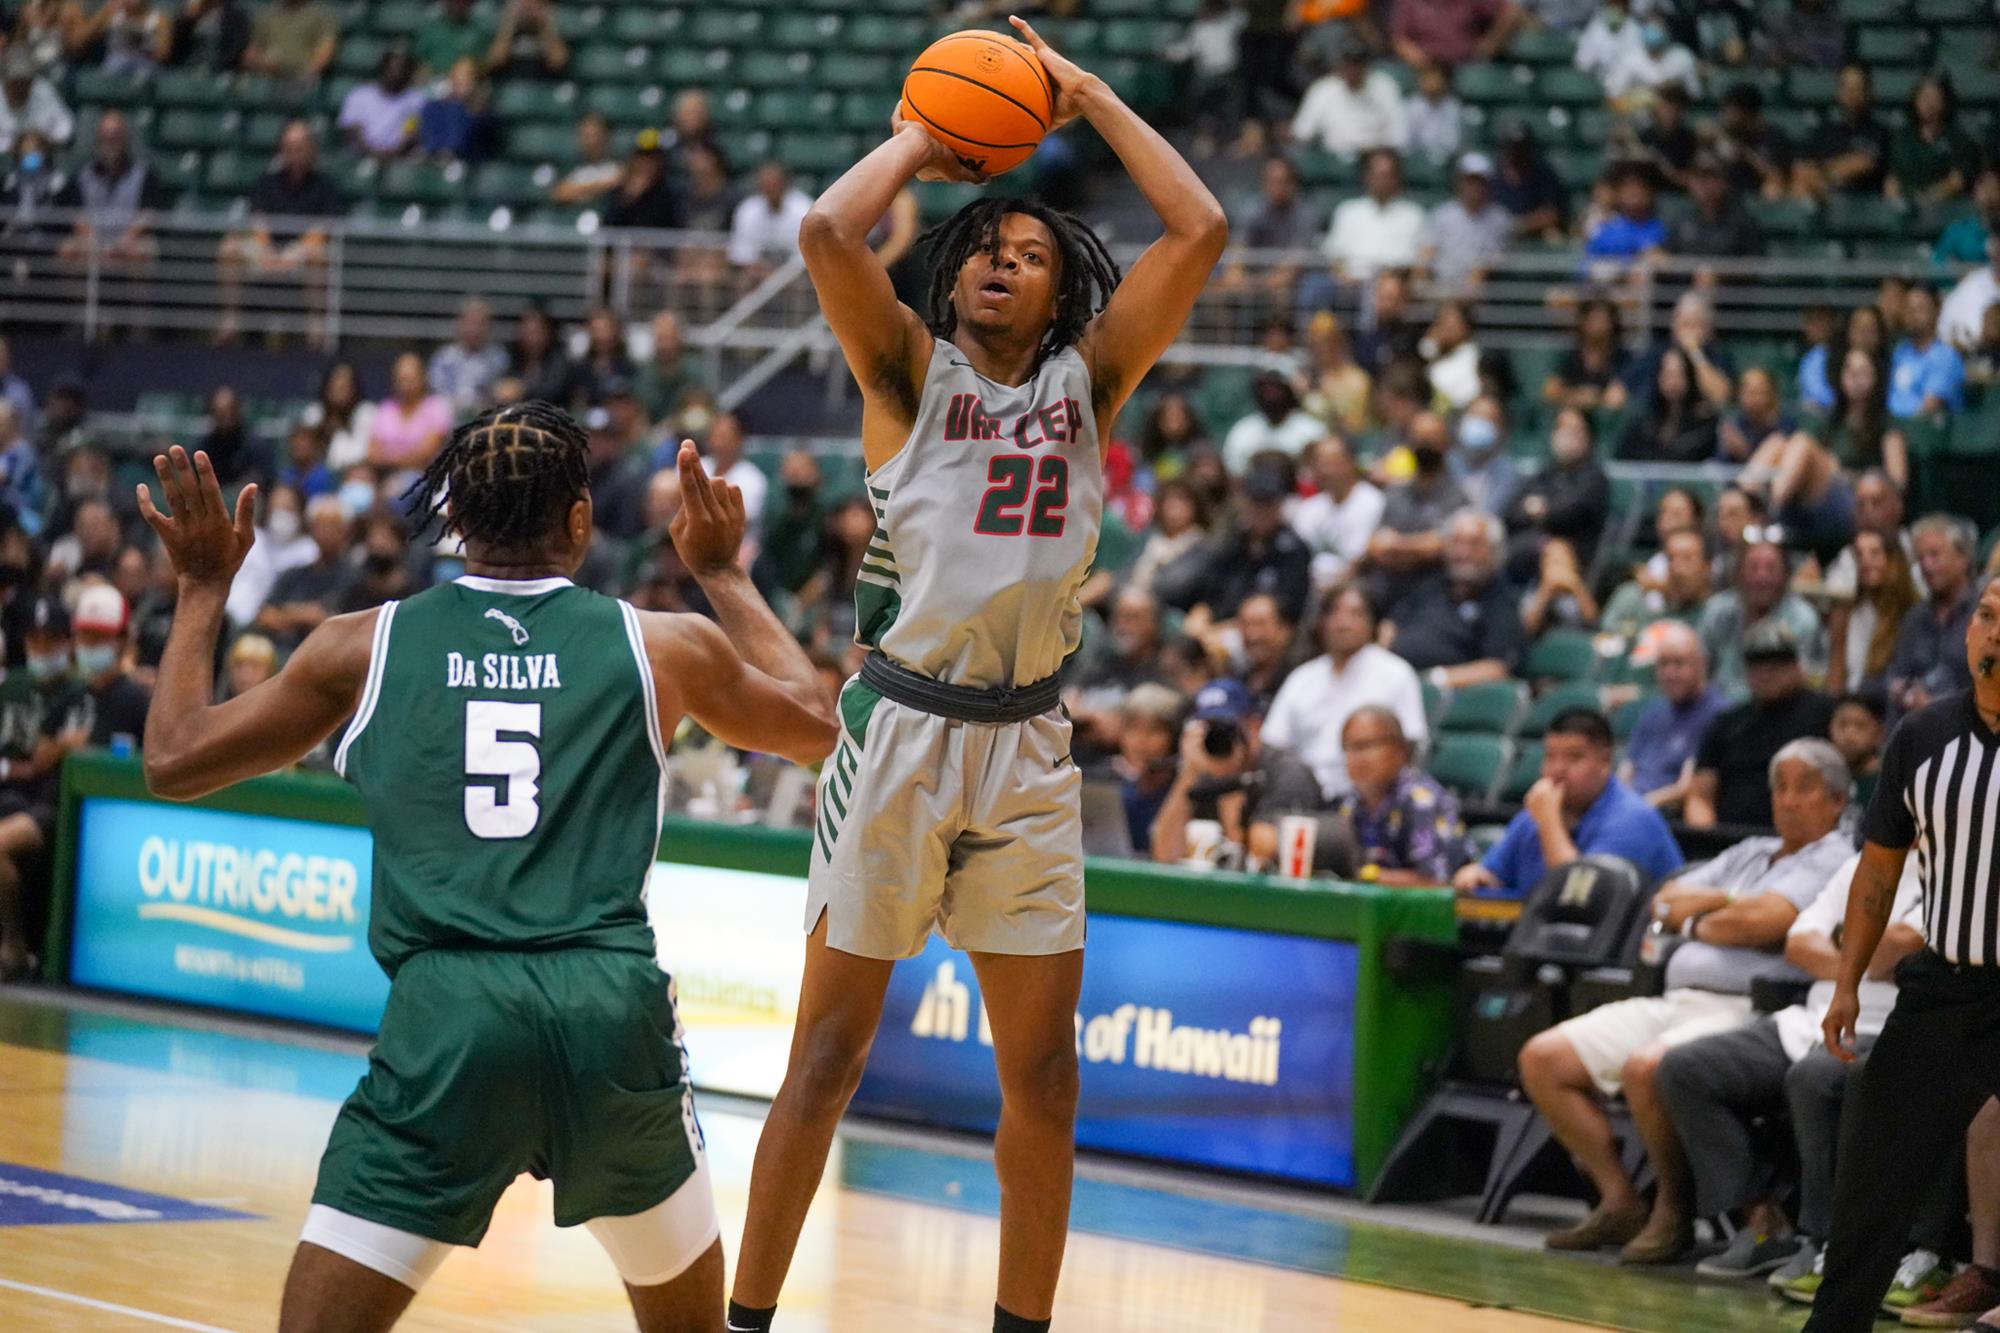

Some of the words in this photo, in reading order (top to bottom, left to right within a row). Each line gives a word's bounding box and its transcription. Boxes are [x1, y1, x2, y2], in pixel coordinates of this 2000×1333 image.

[973, 454, 1069, 538] 22
[483, 653, 561, 689] SILVA
[464, 700, 542, 839] 5
[138, 836, 358, 923] OUTRIGGER
[1085, 1003, 1137, 1064] of
[1134, 1006, 1282, 1086] Hawaii
